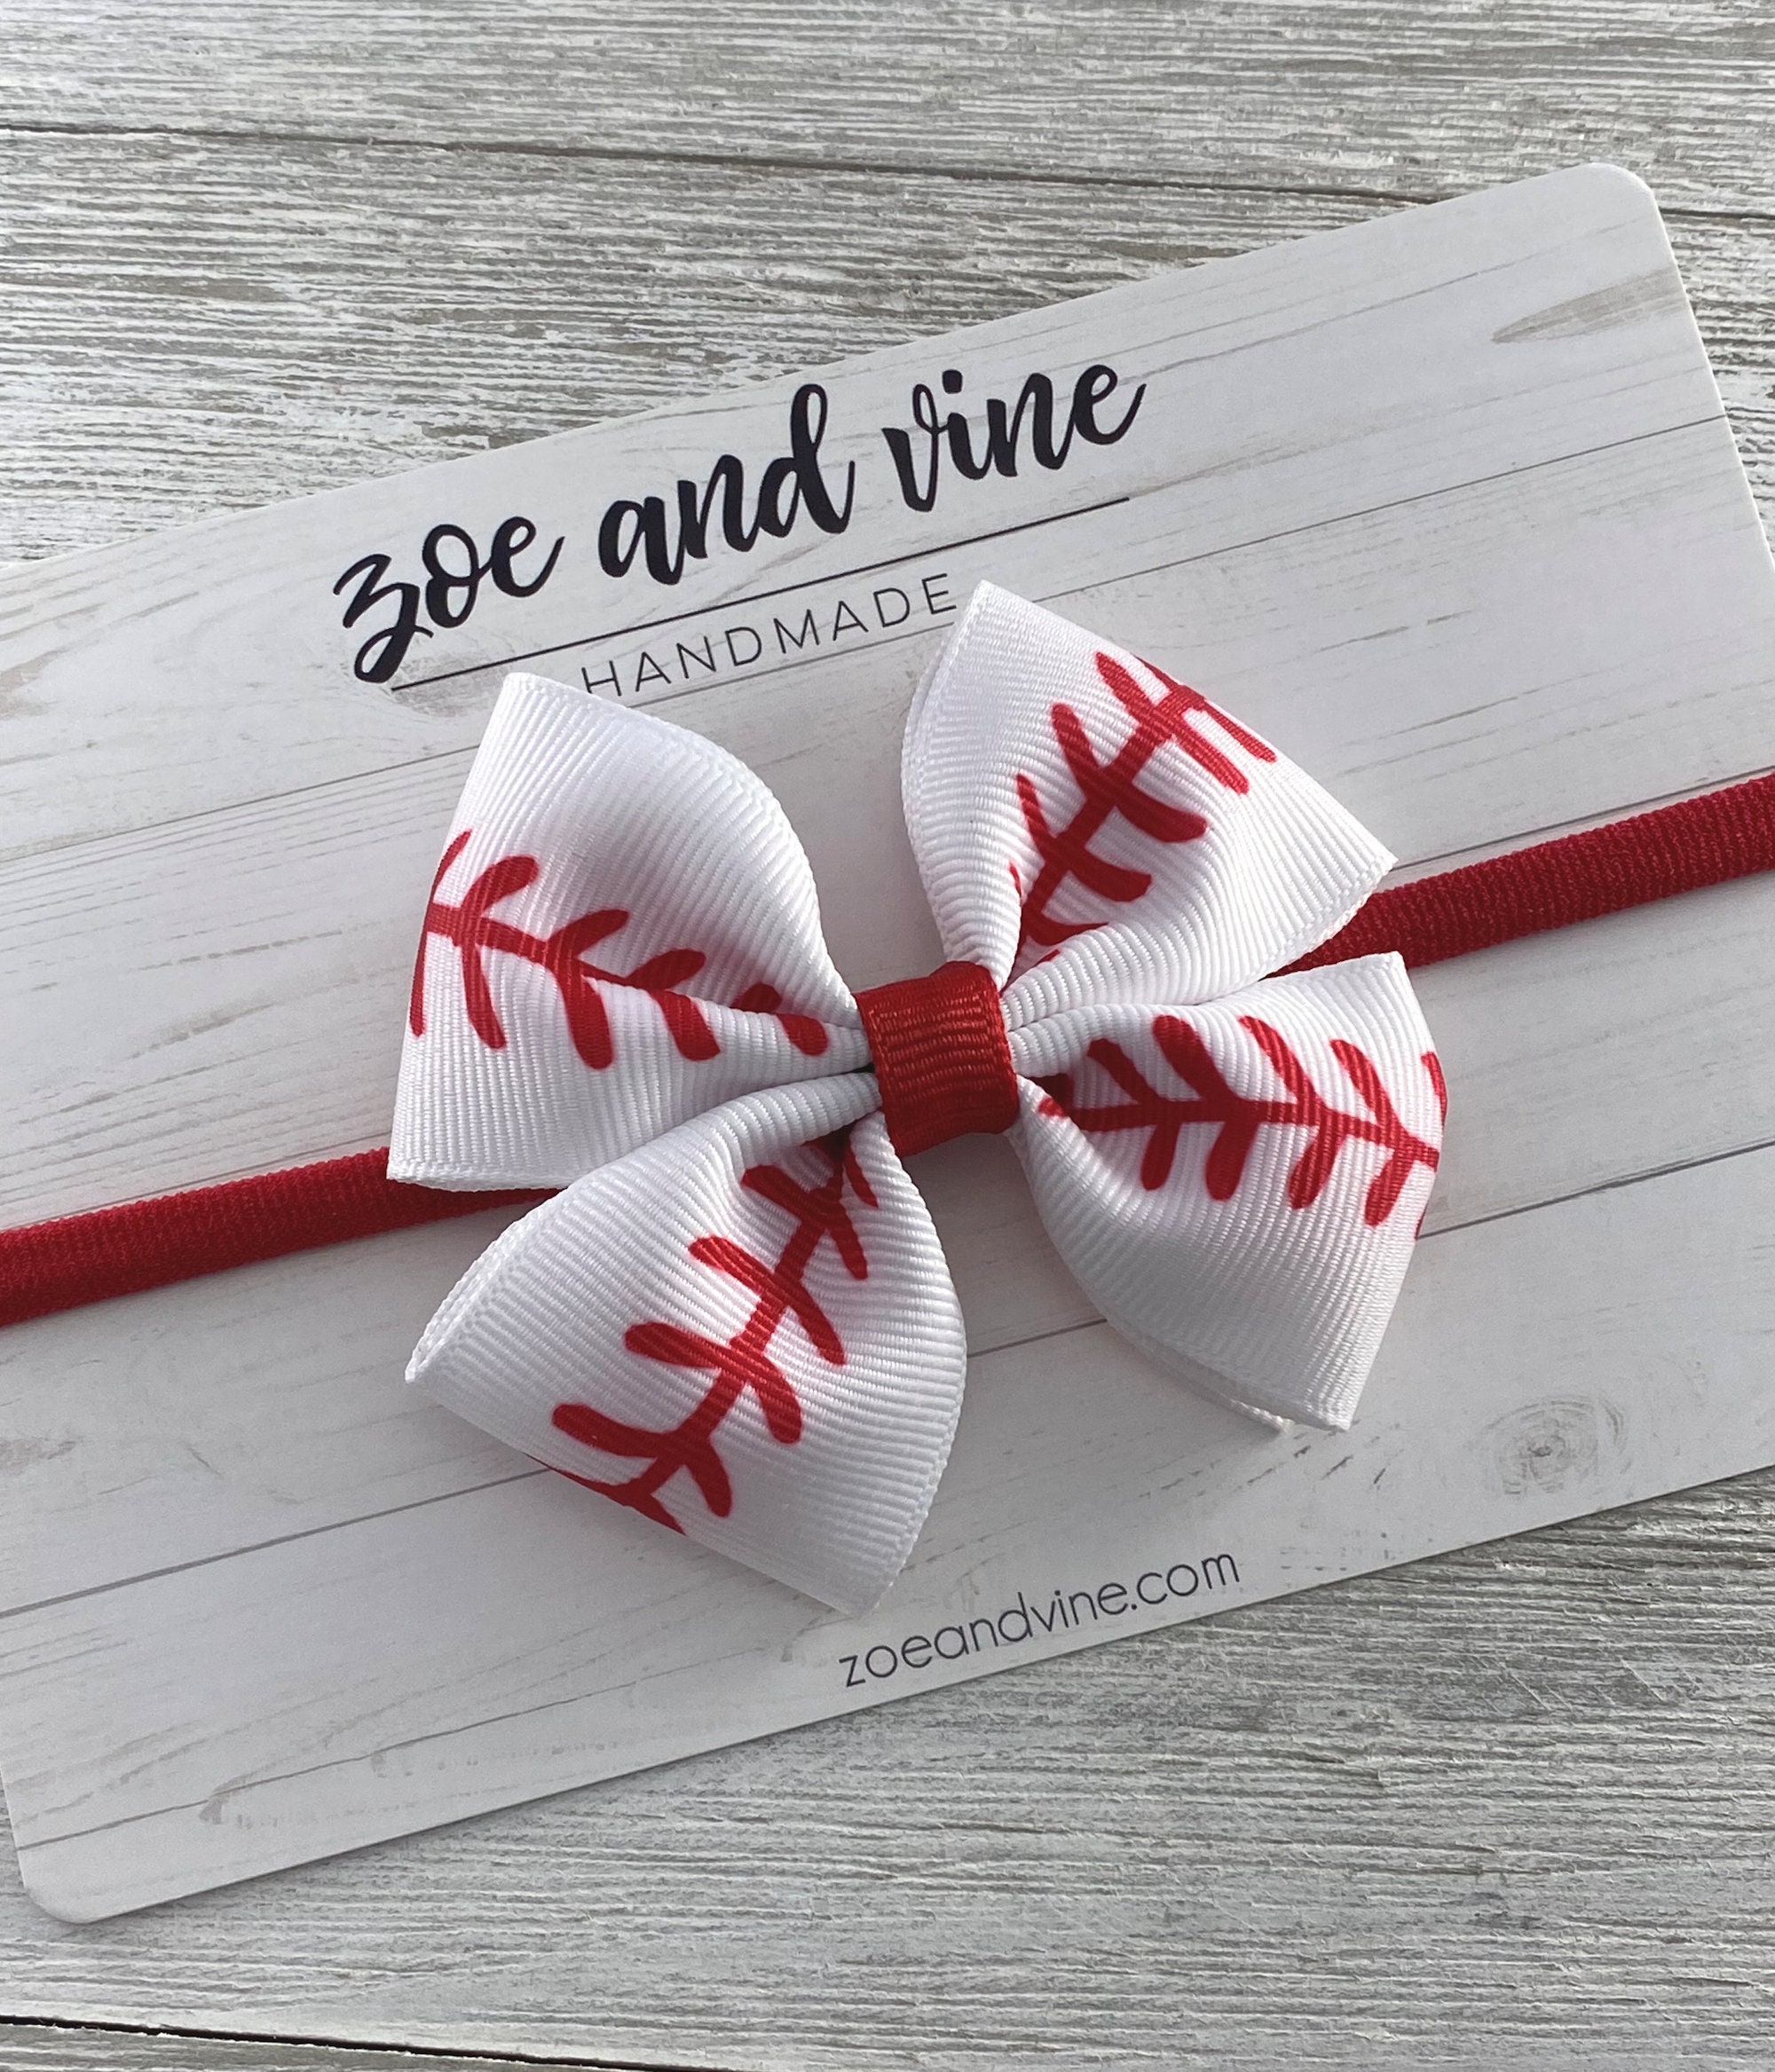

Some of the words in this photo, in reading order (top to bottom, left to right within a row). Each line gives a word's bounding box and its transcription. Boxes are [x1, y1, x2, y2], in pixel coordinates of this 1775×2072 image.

[333, 516, 565, 684] zoe
[597, 383, 856, 586] and
[880, 364, 1147, 513] vine
[581, 573, 957, 697] HANDMADE
[838, 1554, 1240, 1688] zoeandvine.com
